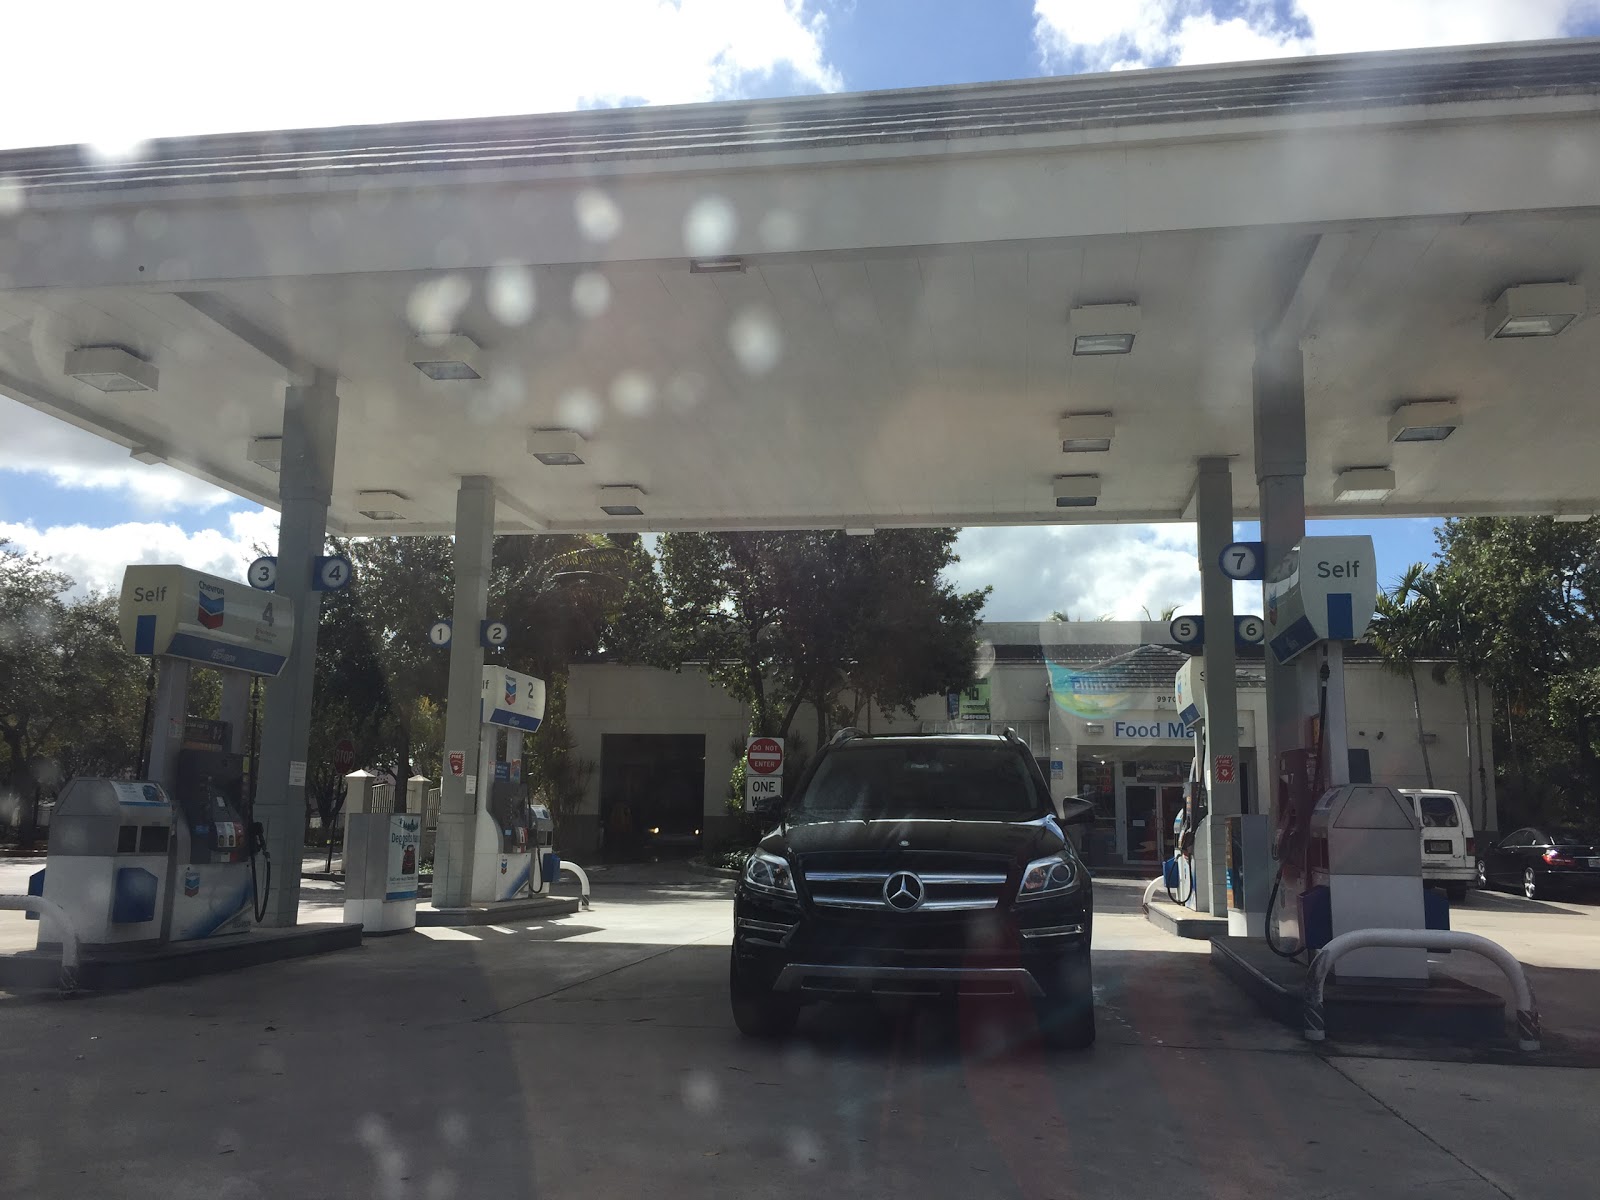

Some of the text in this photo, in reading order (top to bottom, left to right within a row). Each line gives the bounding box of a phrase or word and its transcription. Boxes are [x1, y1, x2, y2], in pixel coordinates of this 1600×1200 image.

[1232, 552, 1246, 570] 7
[1317, 560, 1360, 578] Self
[258, 566, 270, 582] 3
[328, 565, 342, 581] 4
[133, 586, 168, 602] Self
[199, 580, 225, 596] Chevron
[262, 602, 275, 626] 4
[437, 628, 444, 641] 1
[492, 627, 502, 640] 2
[1180, 623, 1191, 637] 5
[1246, 623, 1257, 637] 6
[528, 681, 535, 699] 2
[1115, 721, 1161, 738] Food
[335, 749, 354, 764] STOP
[752, 781, 776, 792] ONE
